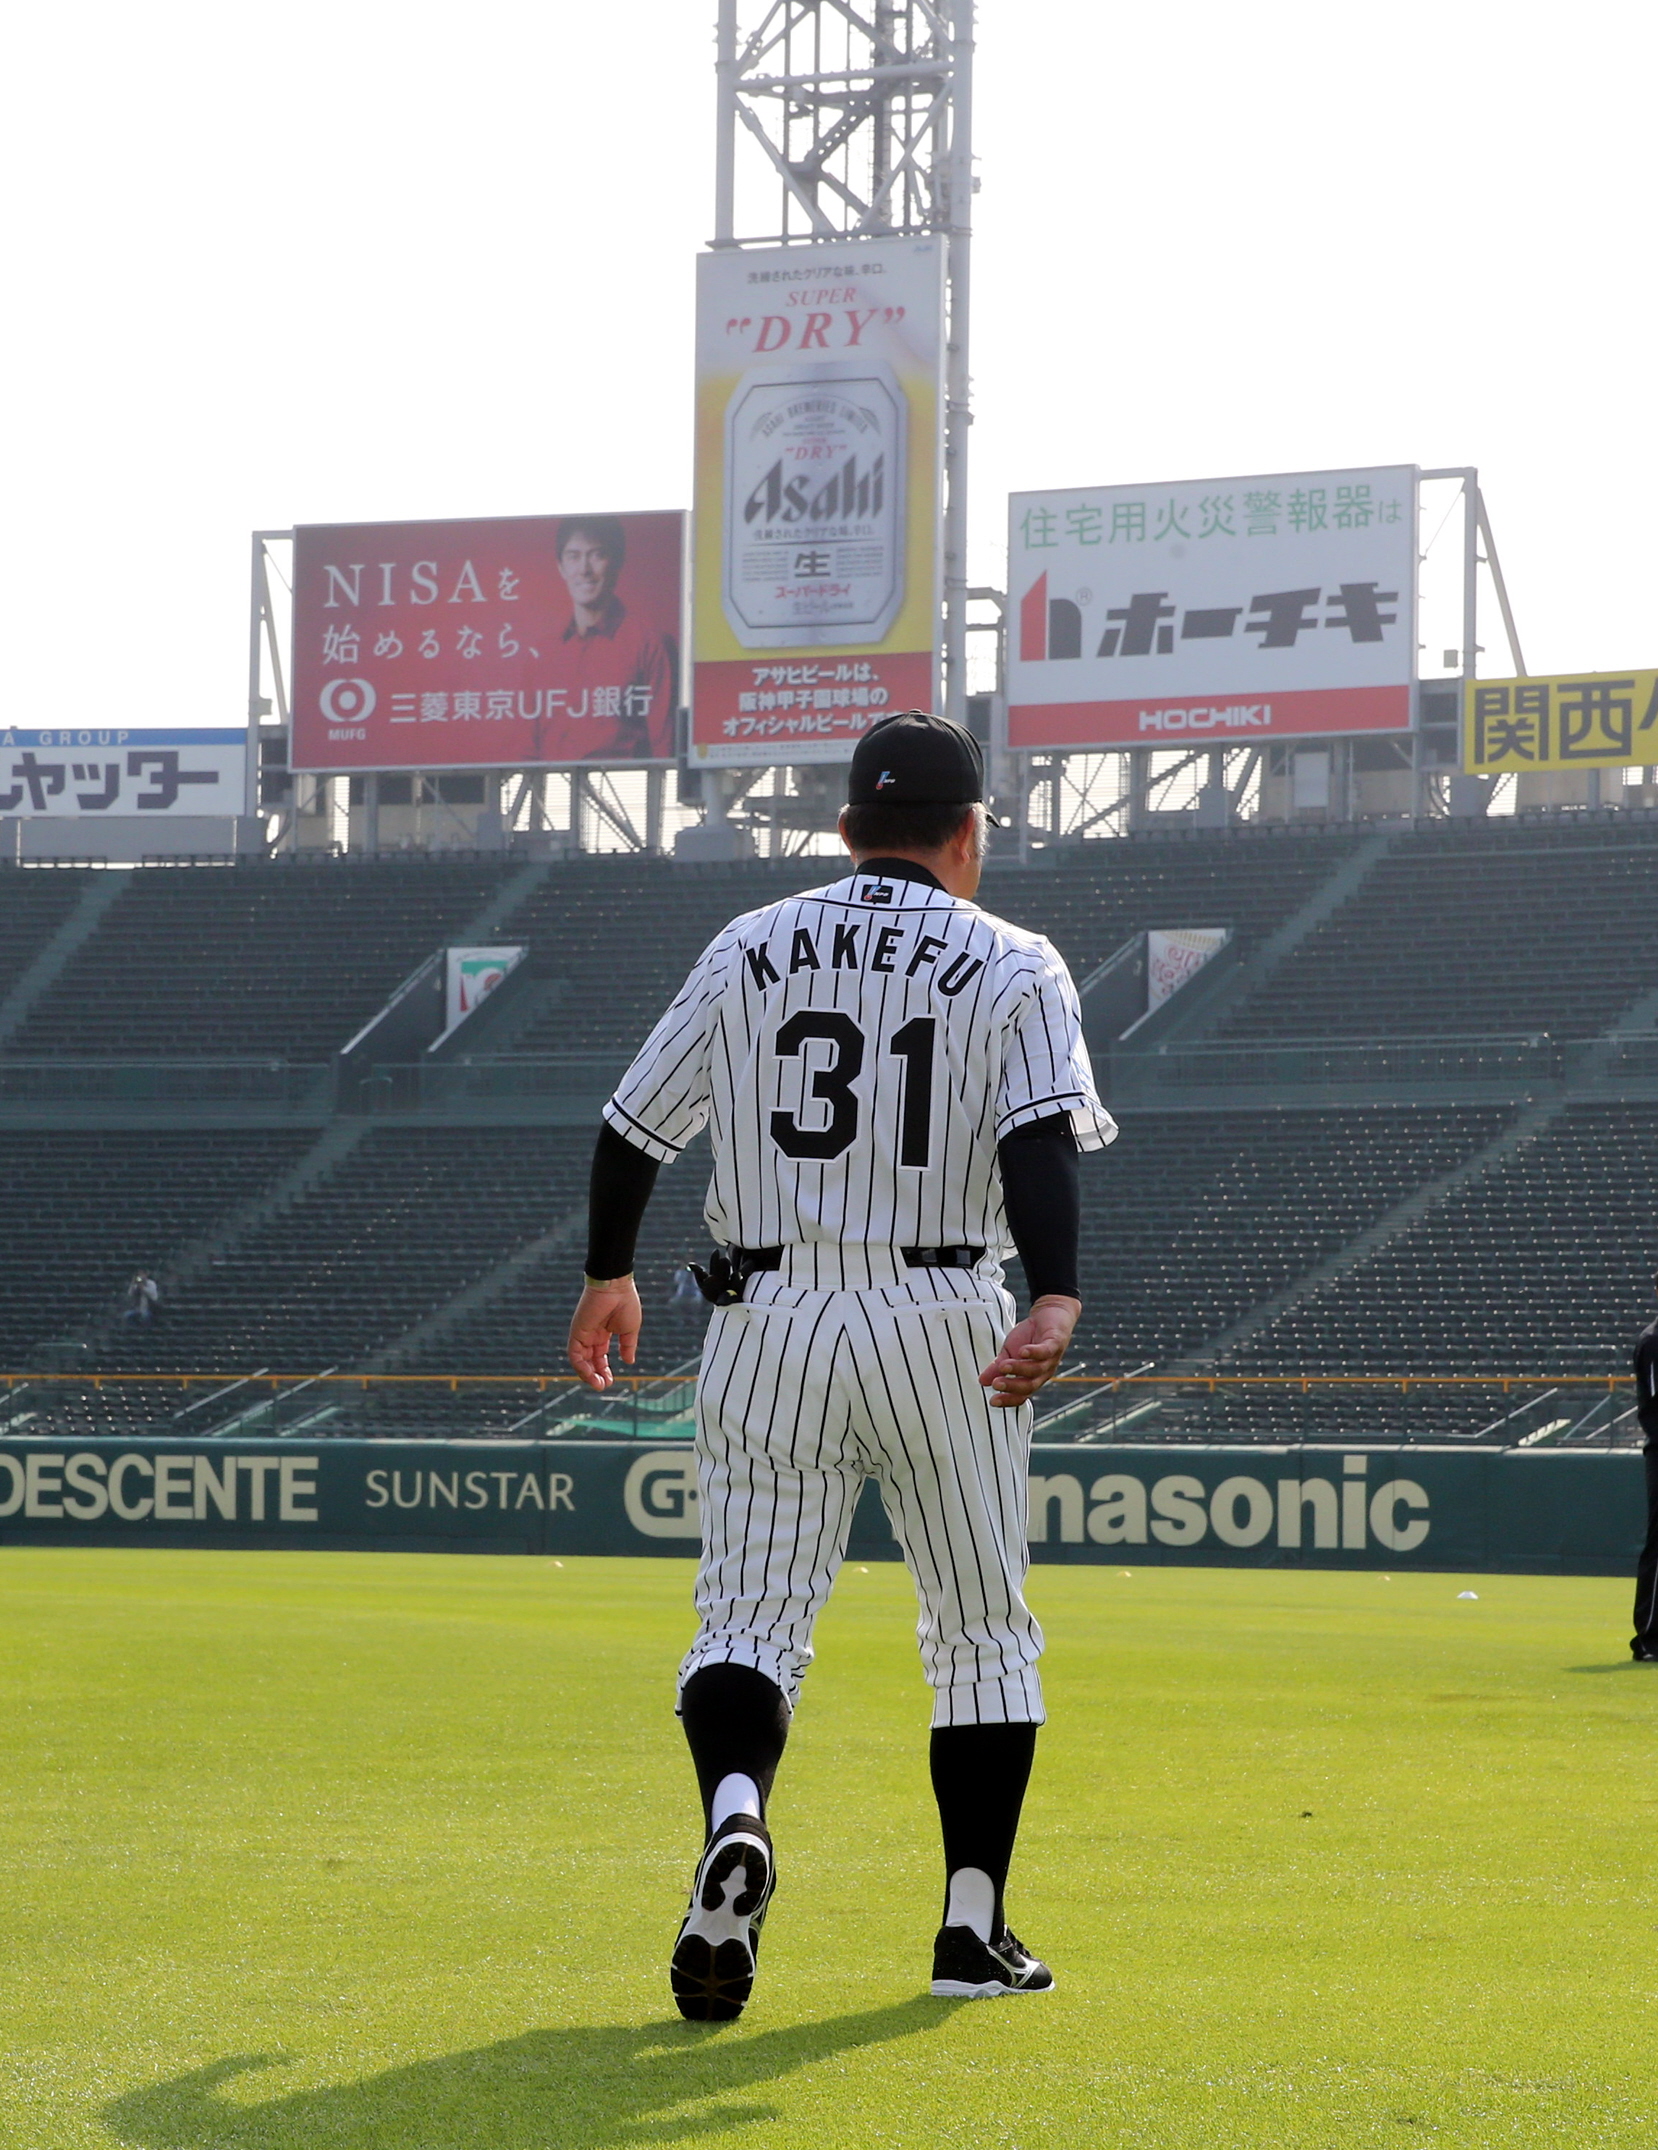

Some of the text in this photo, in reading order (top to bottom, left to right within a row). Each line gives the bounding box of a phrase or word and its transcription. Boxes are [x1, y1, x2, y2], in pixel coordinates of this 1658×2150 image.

[786, 287, 857, 307] SUPER
[744, 452, 884, 525] Asahi
[1019, 484, 1402, 550] 住宅用火災警報器は
[794, 551, 831, 578] 生
[1096, 582, 1399, 658] ホーチキ
[389, 684, 654, 724] 三菱東京UFJ銀行
[738, 687, 889, 712] 阪神甲子園球場の
[1139, 704, 1271, 732] HOCHIKI
[39, 730, 129, 746] GROUP
[328, 728, 366, 741] MUFG
[1474, 677, 1658, 765] 関西
[746, 924, 984, 997] KAKEFU
[770, 1009, 936, 1168] 31
[365, 1468, 576, 1512] SUNSTAR
